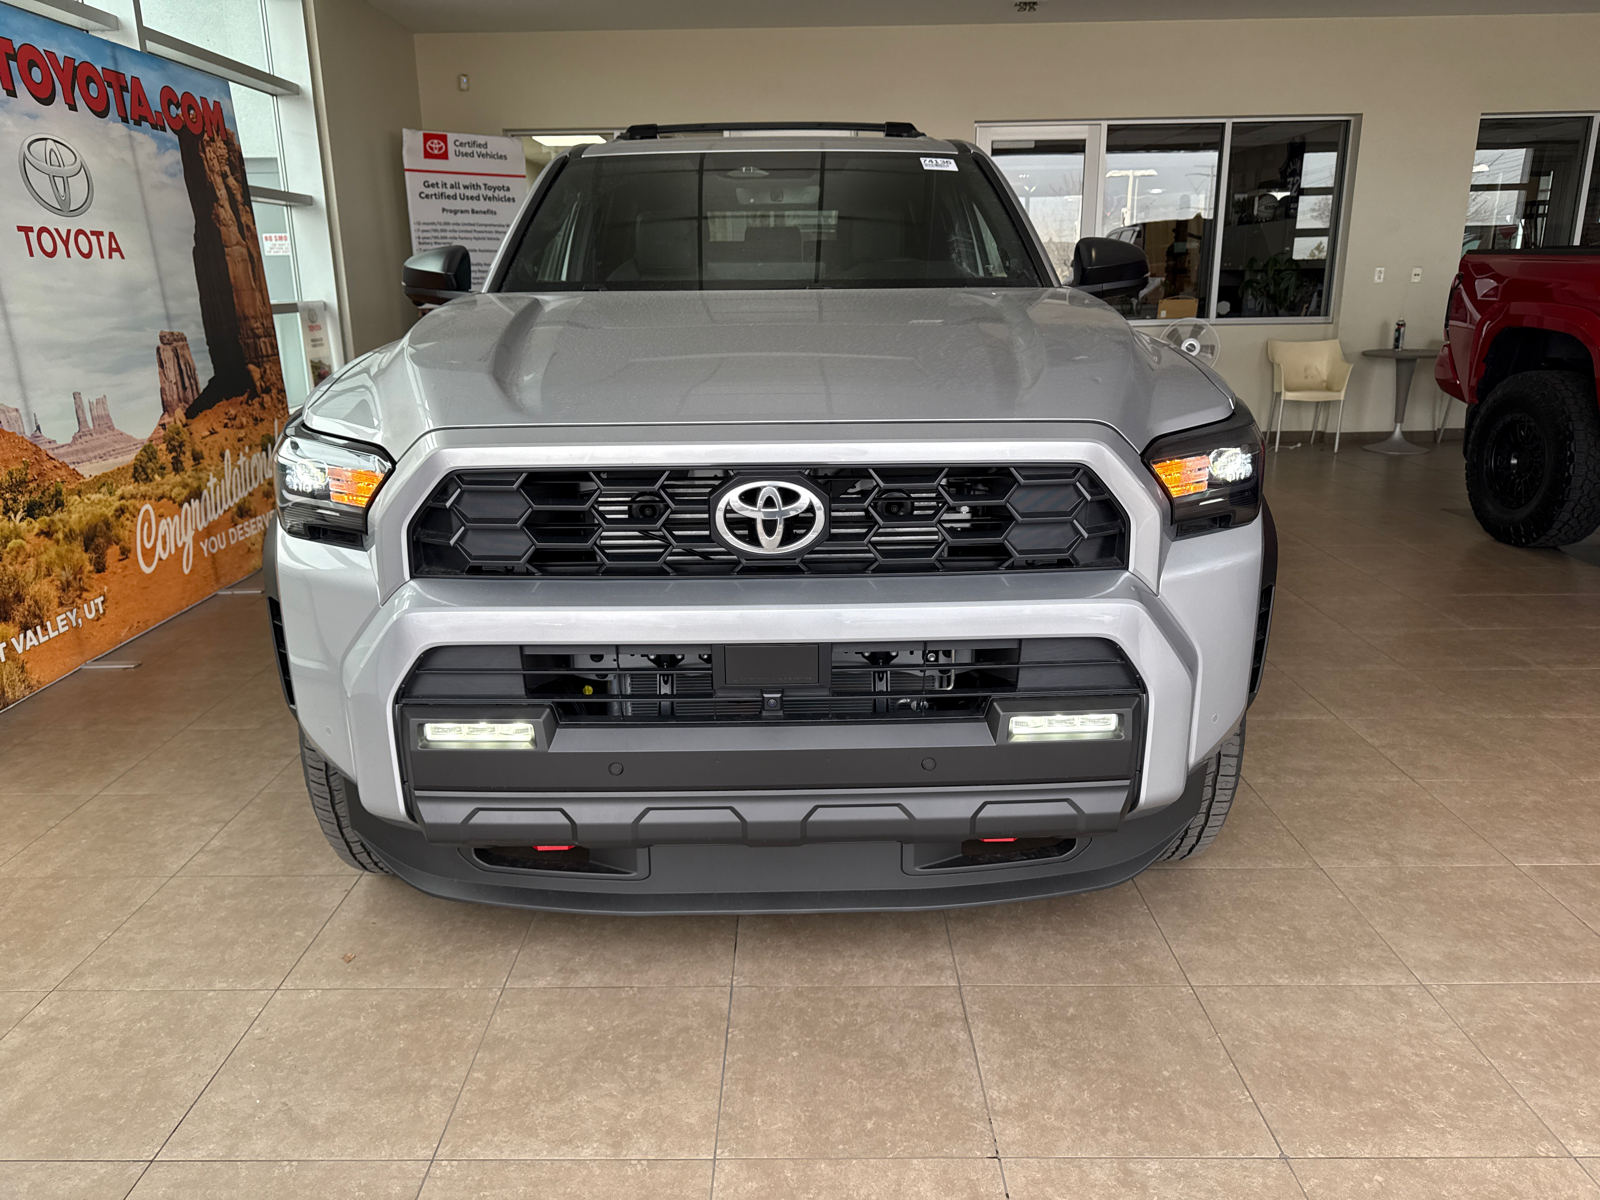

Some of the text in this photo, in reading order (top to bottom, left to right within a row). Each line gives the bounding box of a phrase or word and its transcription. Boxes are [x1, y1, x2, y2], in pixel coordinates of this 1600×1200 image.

[454, 139, 488, 149] Certified
[454, 149, 508, 161] Used Vehicles
[423, 180, 511, 193] Get it all with Toyota
[418, 191, 516, 203] Certified Used Vehicles
[441, 207, 497, 216] Program Benefits
[16, 225, 126, 260] TOYOTA
[200, 531, 227, 557] YOU
[10, 608, 83, 654] VALLEY,
[83, 595, 105, 620] UT
